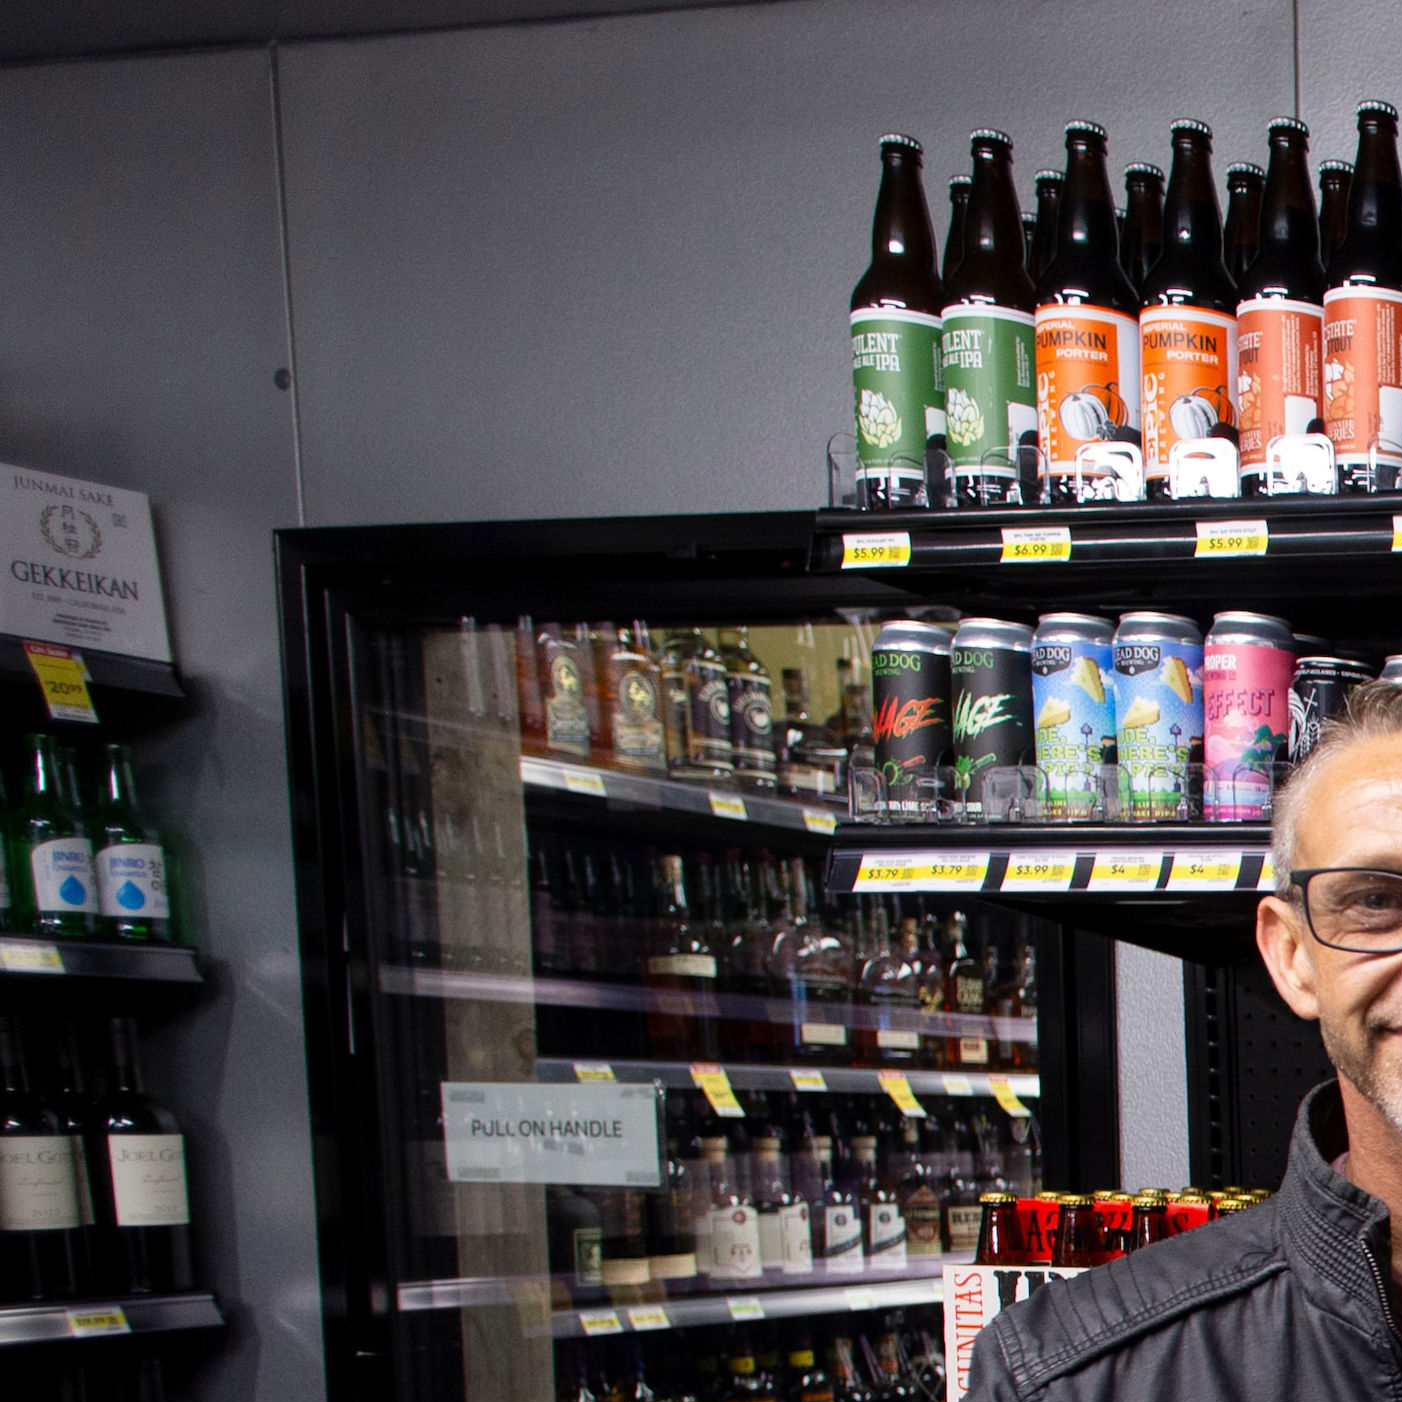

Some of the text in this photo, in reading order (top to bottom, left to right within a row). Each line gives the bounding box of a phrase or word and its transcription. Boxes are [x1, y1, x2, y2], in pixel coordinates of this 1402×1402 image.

[1036, 331, 1107, 349] PUMPKIN
[1143, 333, 1217, 352] PUMPKIN
[959, 351, 983, 369] IPA
[1056, 347, 1108, 361] PORTER
[1166, 350, 1218, 364] PORTER
[875, 354, 900, 371] IPA
[13, 475, 75, 498] JUNMAI
[1014, 544, 1047, 556] $6.99
[1208, 537, 1243, 550] $5.99
[853, 547, 885, 560] $5.99
[11, 560, 139, 601] GEKKEIKAN
[964, 651, 994, 668] DOG
[1050, 647, 1070, 662] DOG
[1137, 647, 1160, 661] DOG
[889, 654, 921, 671] DOG
[867, 868, 898, 880] $3.79
[931, 864, 962, 876] $3.79
[1016, 864, 1048, 877] $3.99
[472, 1119, 623, 1138] PULL ON HANDLE
